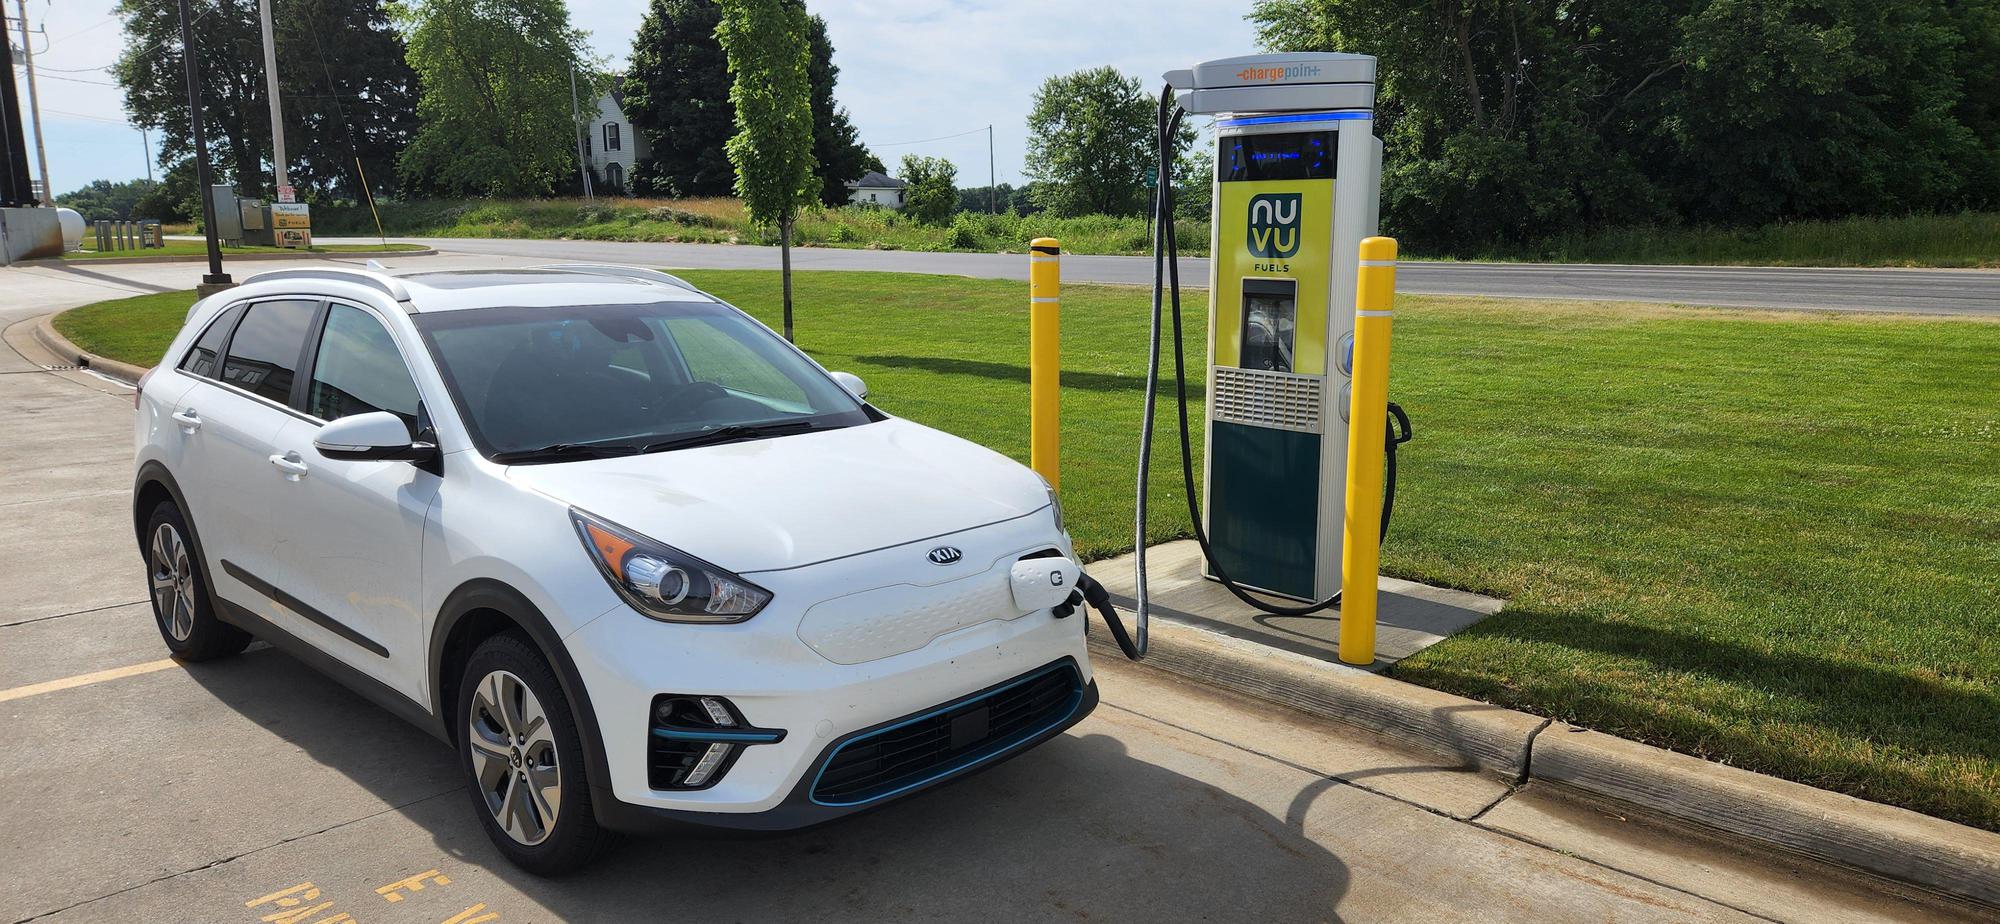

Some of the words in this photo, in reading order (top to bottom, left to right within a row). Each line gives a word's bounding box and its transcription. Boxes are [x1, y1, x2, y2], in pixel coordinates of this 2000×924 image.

[1254, 263, 1290, 273] FUELS
[931, 547, 961, 562] KIA
[511, 748, 520, 767] KIA
